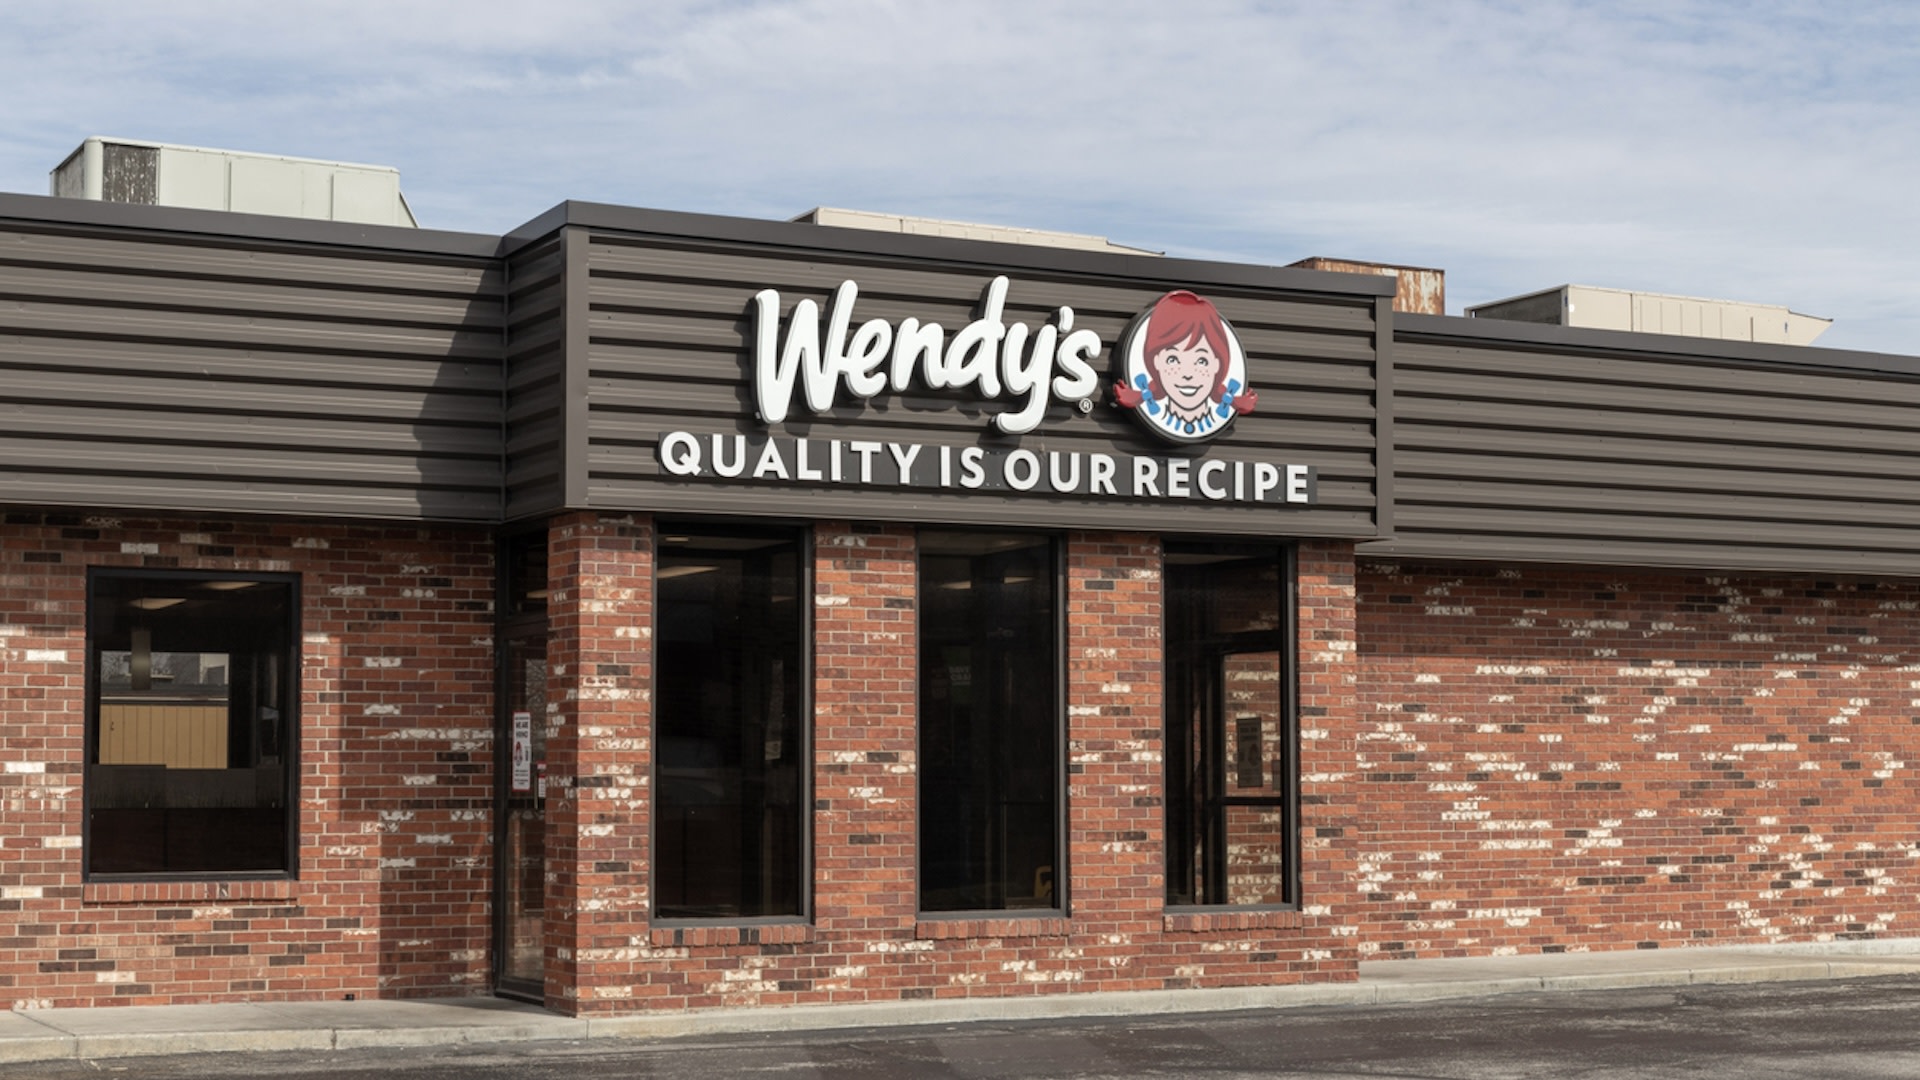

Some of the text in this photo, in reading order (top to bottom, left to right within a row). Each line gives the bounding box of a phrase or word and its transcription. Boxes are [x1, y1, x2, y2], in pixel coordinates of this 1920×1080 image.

[755, 275, 1101, 434] Wendy's
[660, 431, 1309, 503] QUALITY IS OUR RECIPE
